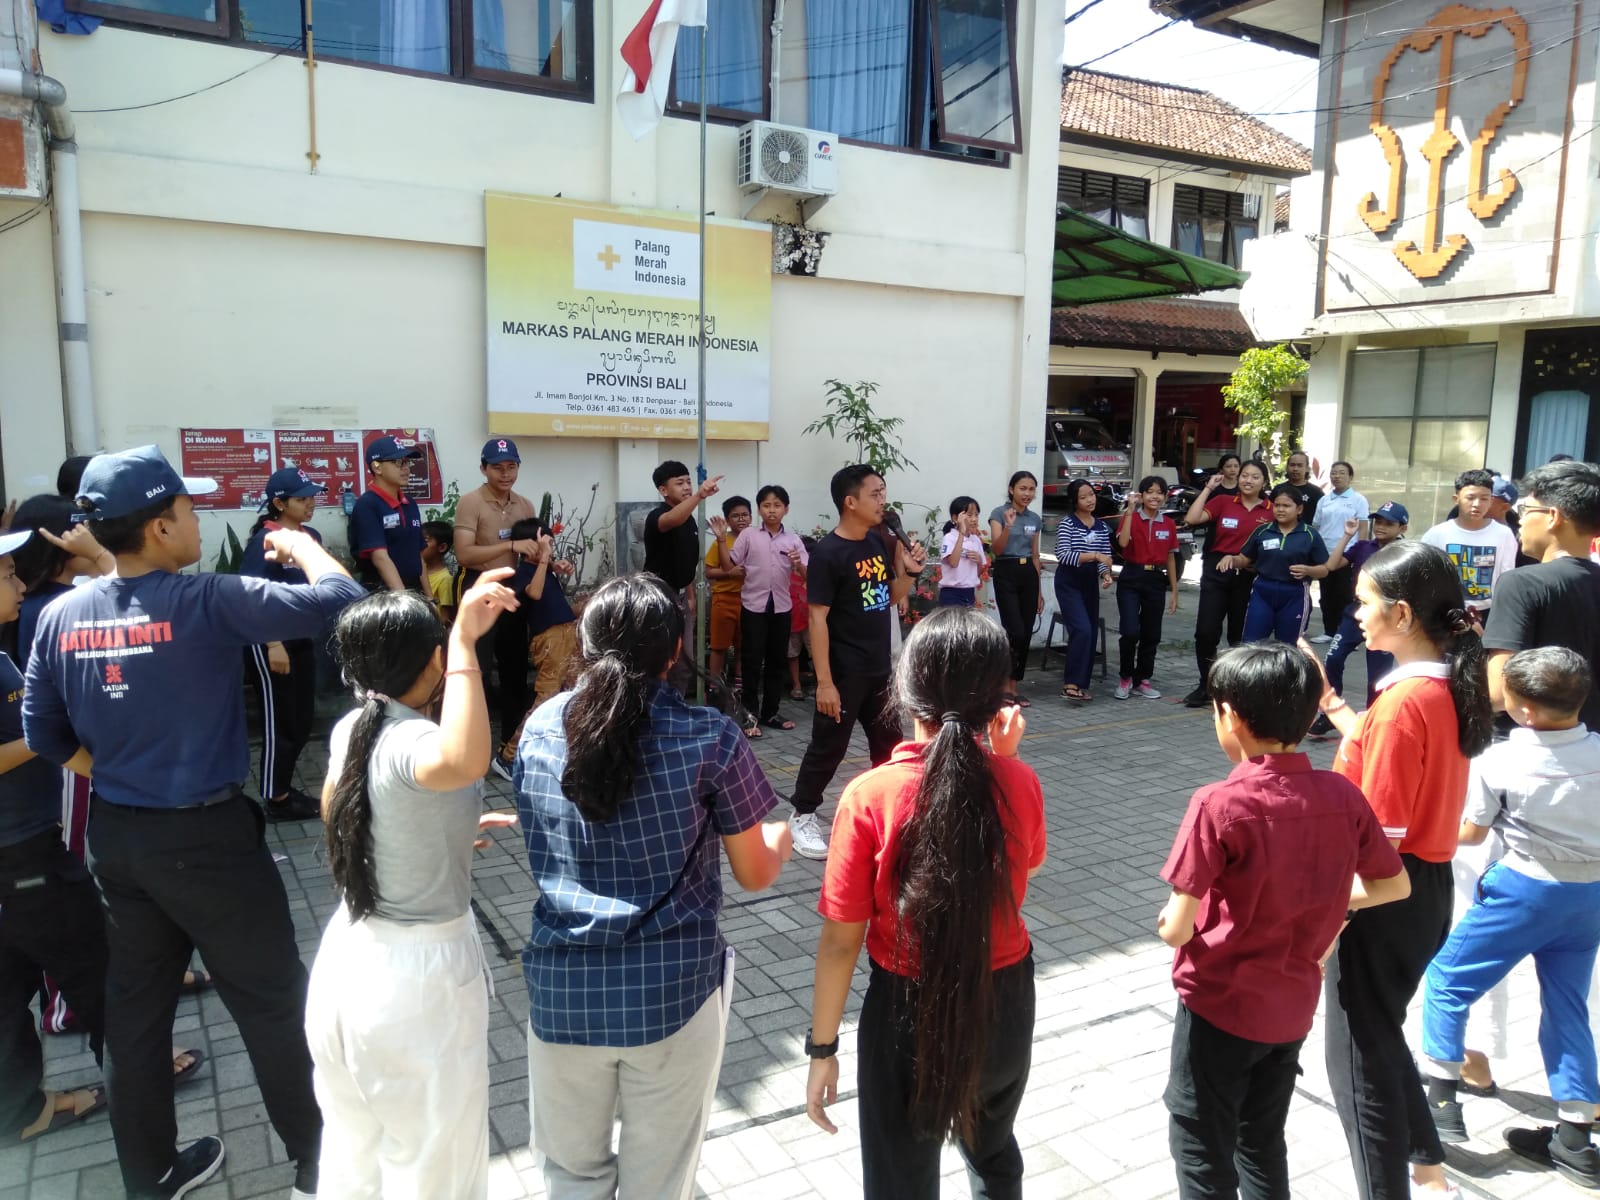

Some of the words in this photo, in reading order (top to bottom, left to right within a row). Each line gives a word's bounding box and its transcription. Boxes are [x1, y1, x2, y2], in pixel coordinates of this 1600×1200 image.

[634, 239, 670, 256] Palang
[634, 255, 667, 270] Merah
[634, 270, 686, 286] Indonesia
[502, 321, 569, 338] MARKAS
[573, 326, 632, 343] PALANG
[635, 331, 685, 347] MERAH
[586, 372, 652, 389] PROVINSI
[656, 377, 687, 390] BALI
[534, 391, 544, 399] Jl.
[546, 392, 566, 400] Imam
[568, 392, 592, 402] Bonjol
[594, 394, 608, 402] Km.
[617, 395, 629, 403] No.
[646, 397, 677, 405] Denpasar
[683, 398, 696, 406] Bali
[565, 403, 584, 412] Telp.
[586, 404, 604, 412] 0361
[607, 405, 620, 413] 483
[644, 406, 658, 414] Fax.
[660, 407, 676, 415] 0361
[679, 408, 691, 416] 490
[185, 436, 195, 444] DI
[195, 436, 227, 444] RUMAH
[145, 484, 167, 499] BALI
[127, 621, 173, 646] INTI
[102, 683, 129, 692] SATUAN
[110, 691, 124, 699] INTI
